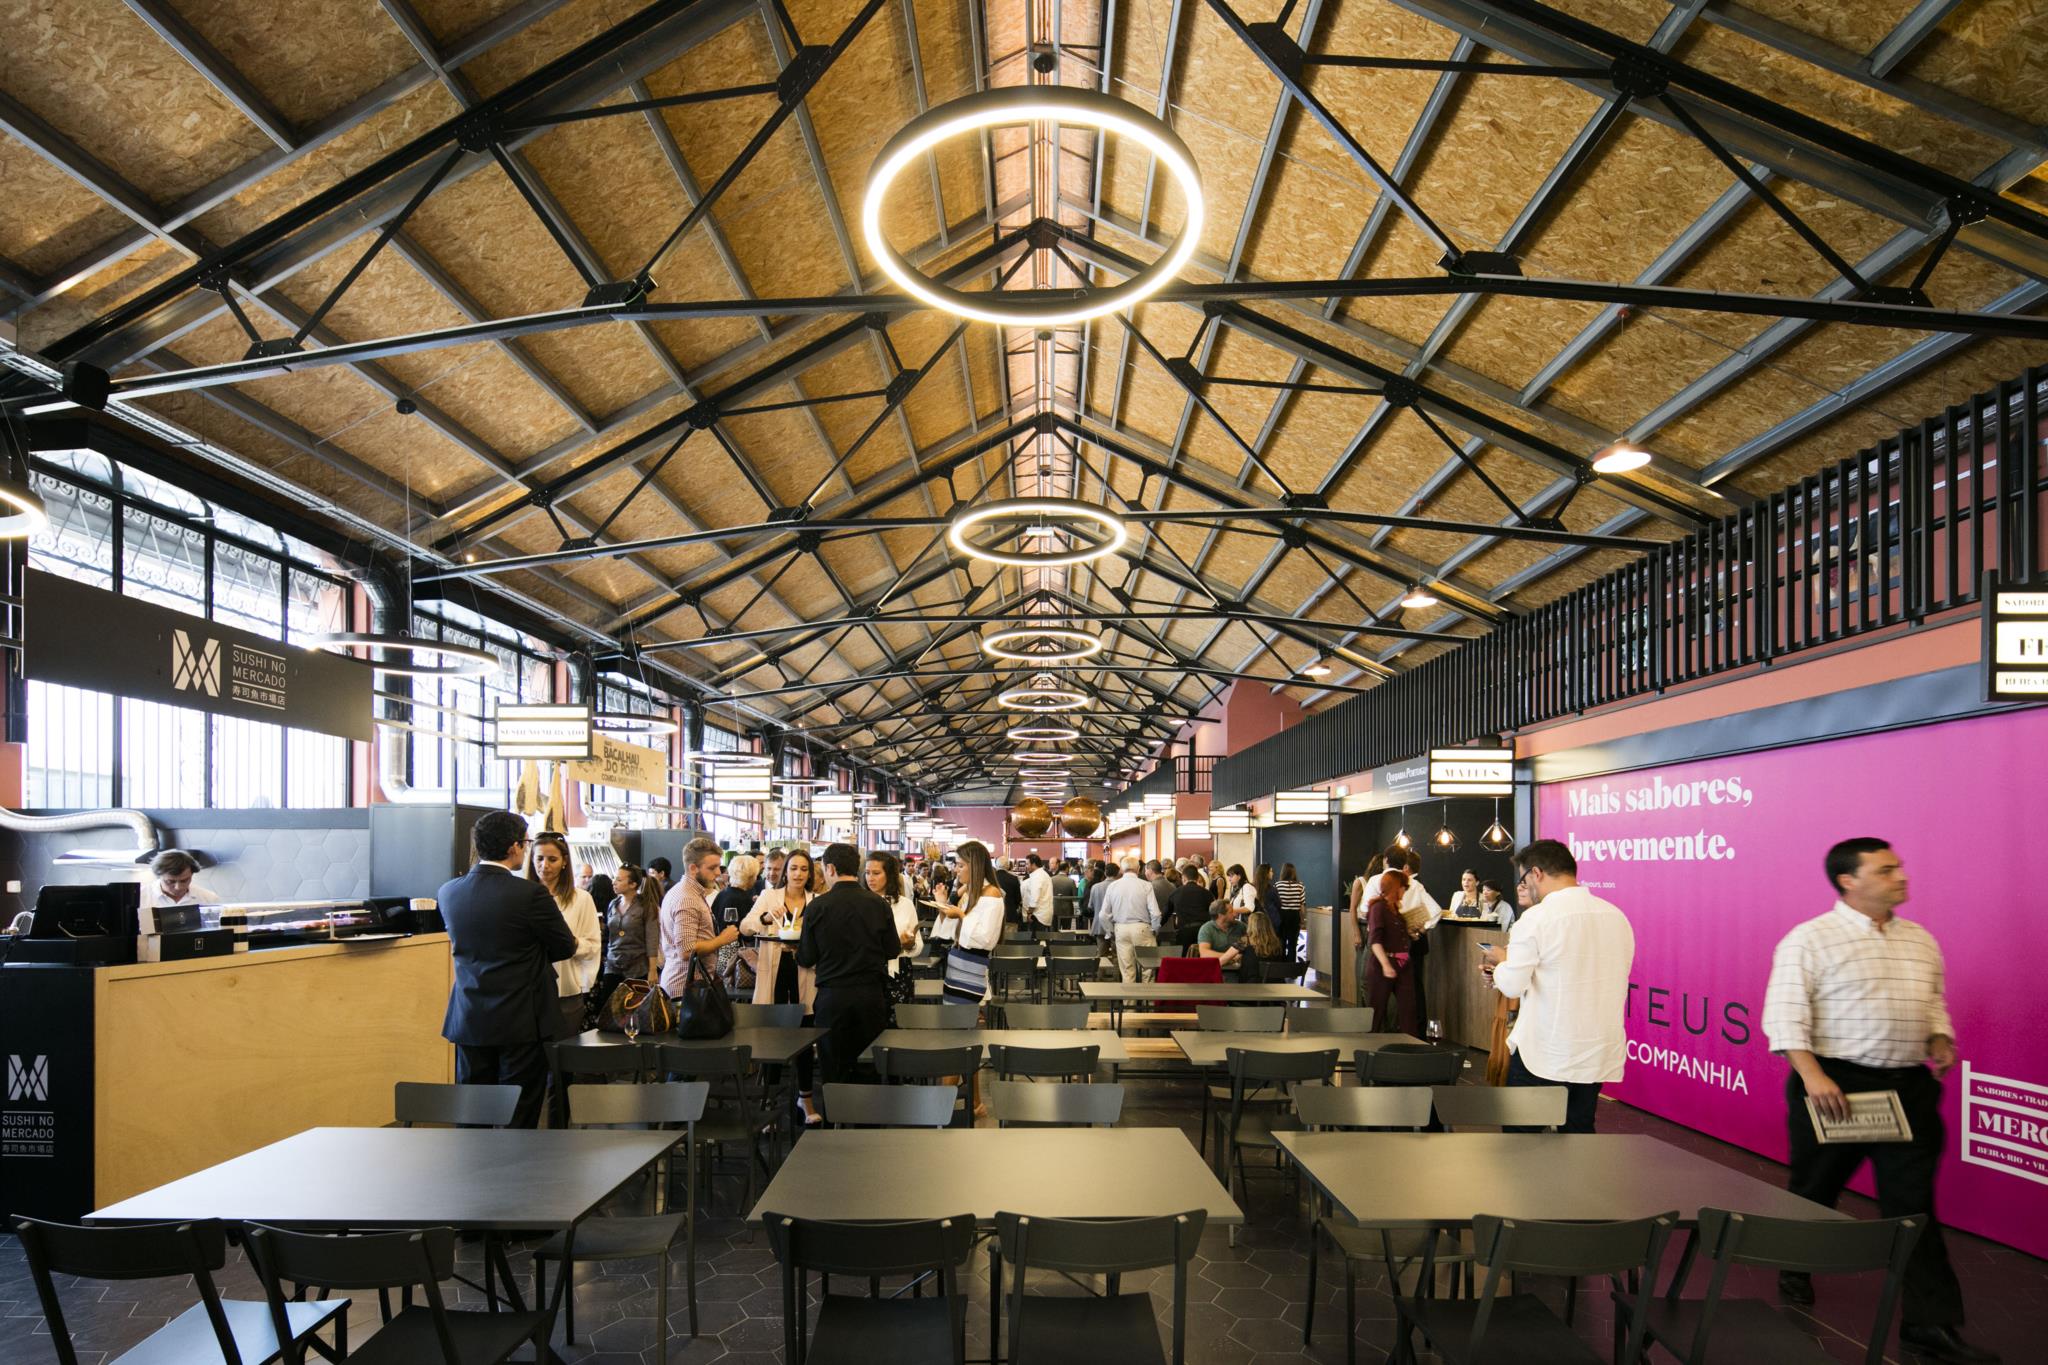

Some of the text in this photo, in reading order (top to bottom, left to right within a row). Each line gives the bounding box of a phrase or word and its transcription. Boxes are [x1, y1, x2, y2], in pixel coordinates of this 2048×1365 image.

[233, 650, 286, 674] SUSHI NO
[232, 665, 286, 688] MERCADO
[1568, 776, 1753, 817] Mais sabores,
[1568, 828, 1736, 862] brevemente.
[1626, 983, 1750, 1045] TEUS
[1626, 1039, 1749, 1096] COMPANHIA
[1977, 1085, 2048, 1108] SABORES TRAD
[2, 1115, 54, 1126] SUSHI NO
[2, 1128, 54, 1139] MERCADO
[1977, 1110, 2048, 1147] MERC
[1977, 1146, 2048, 1172] BEIRA-RIO VIL
